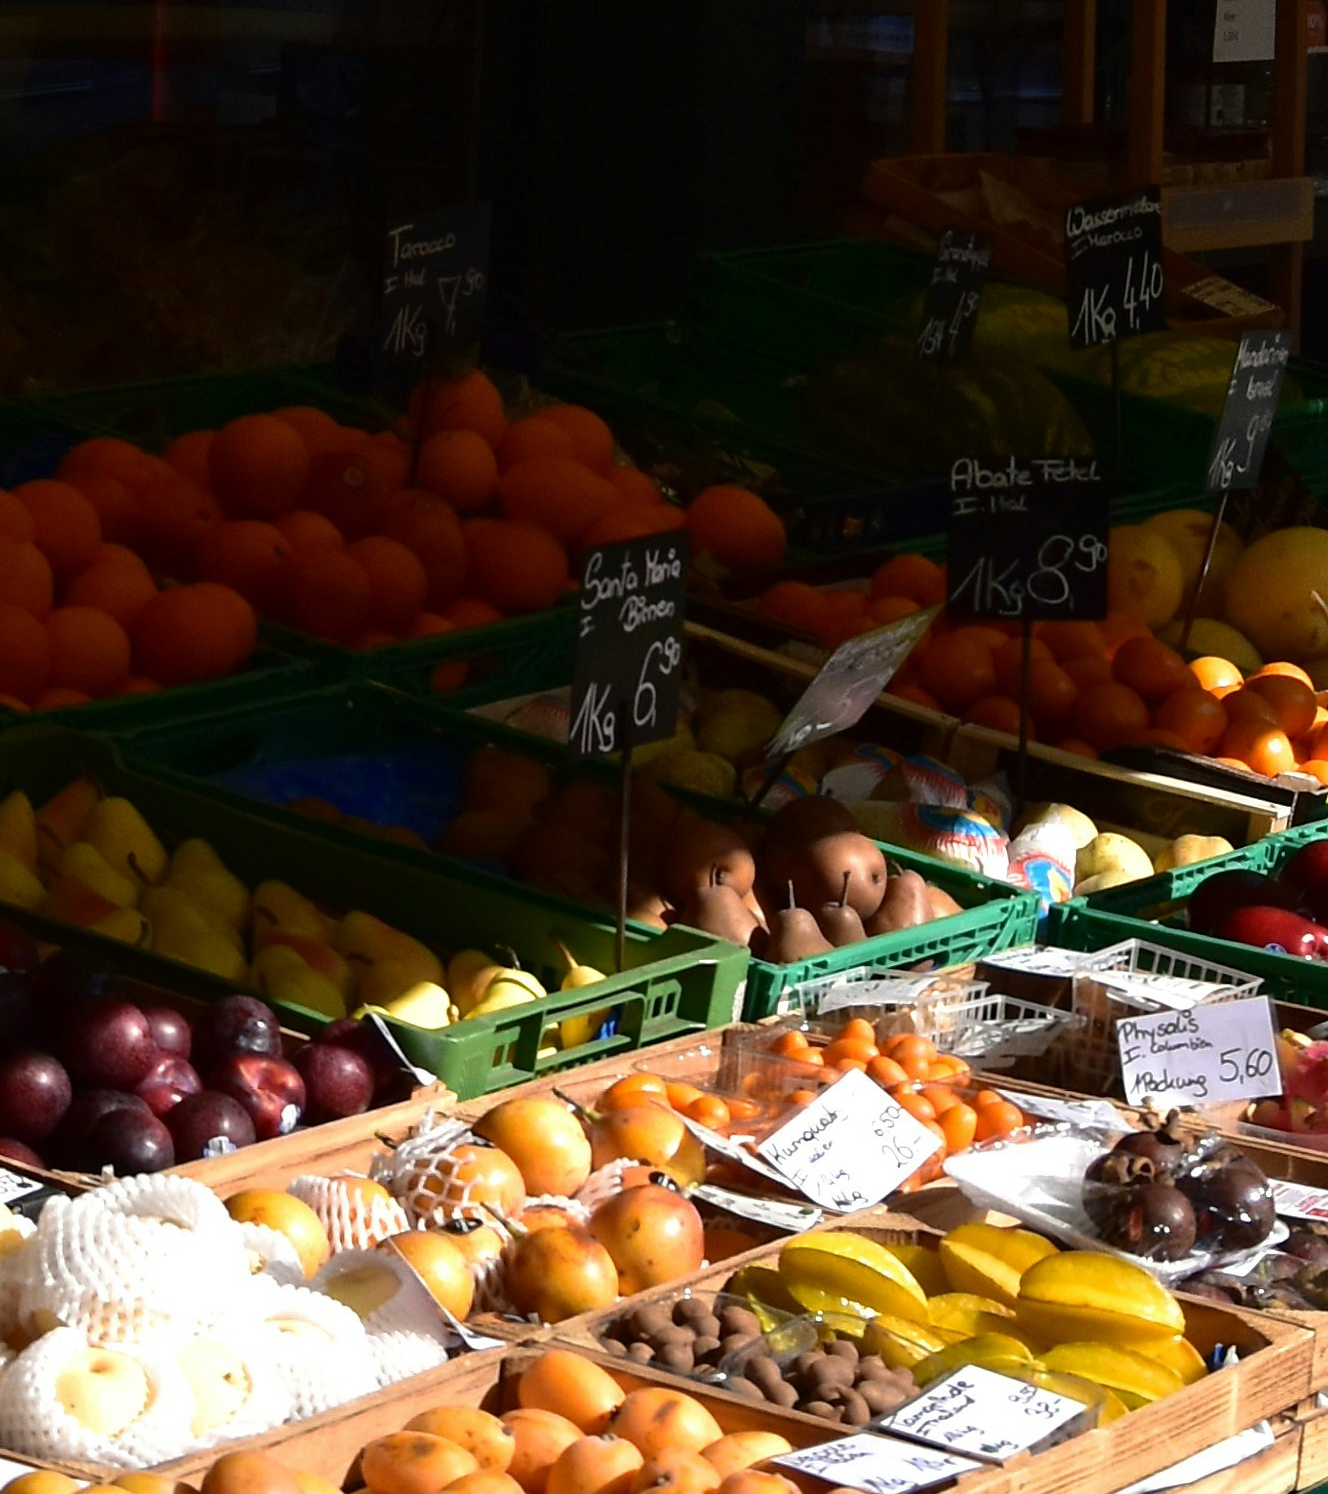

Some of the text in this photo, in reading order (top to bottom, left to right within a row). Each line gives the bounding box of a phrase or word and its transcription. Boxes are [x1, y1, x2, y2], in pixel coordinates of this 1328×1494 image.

[581, 550, 638, 610] Santa
[1118, 1009, 1200, 1043] Physalis
[1219, 1047, 1274, 1085] 5,60
